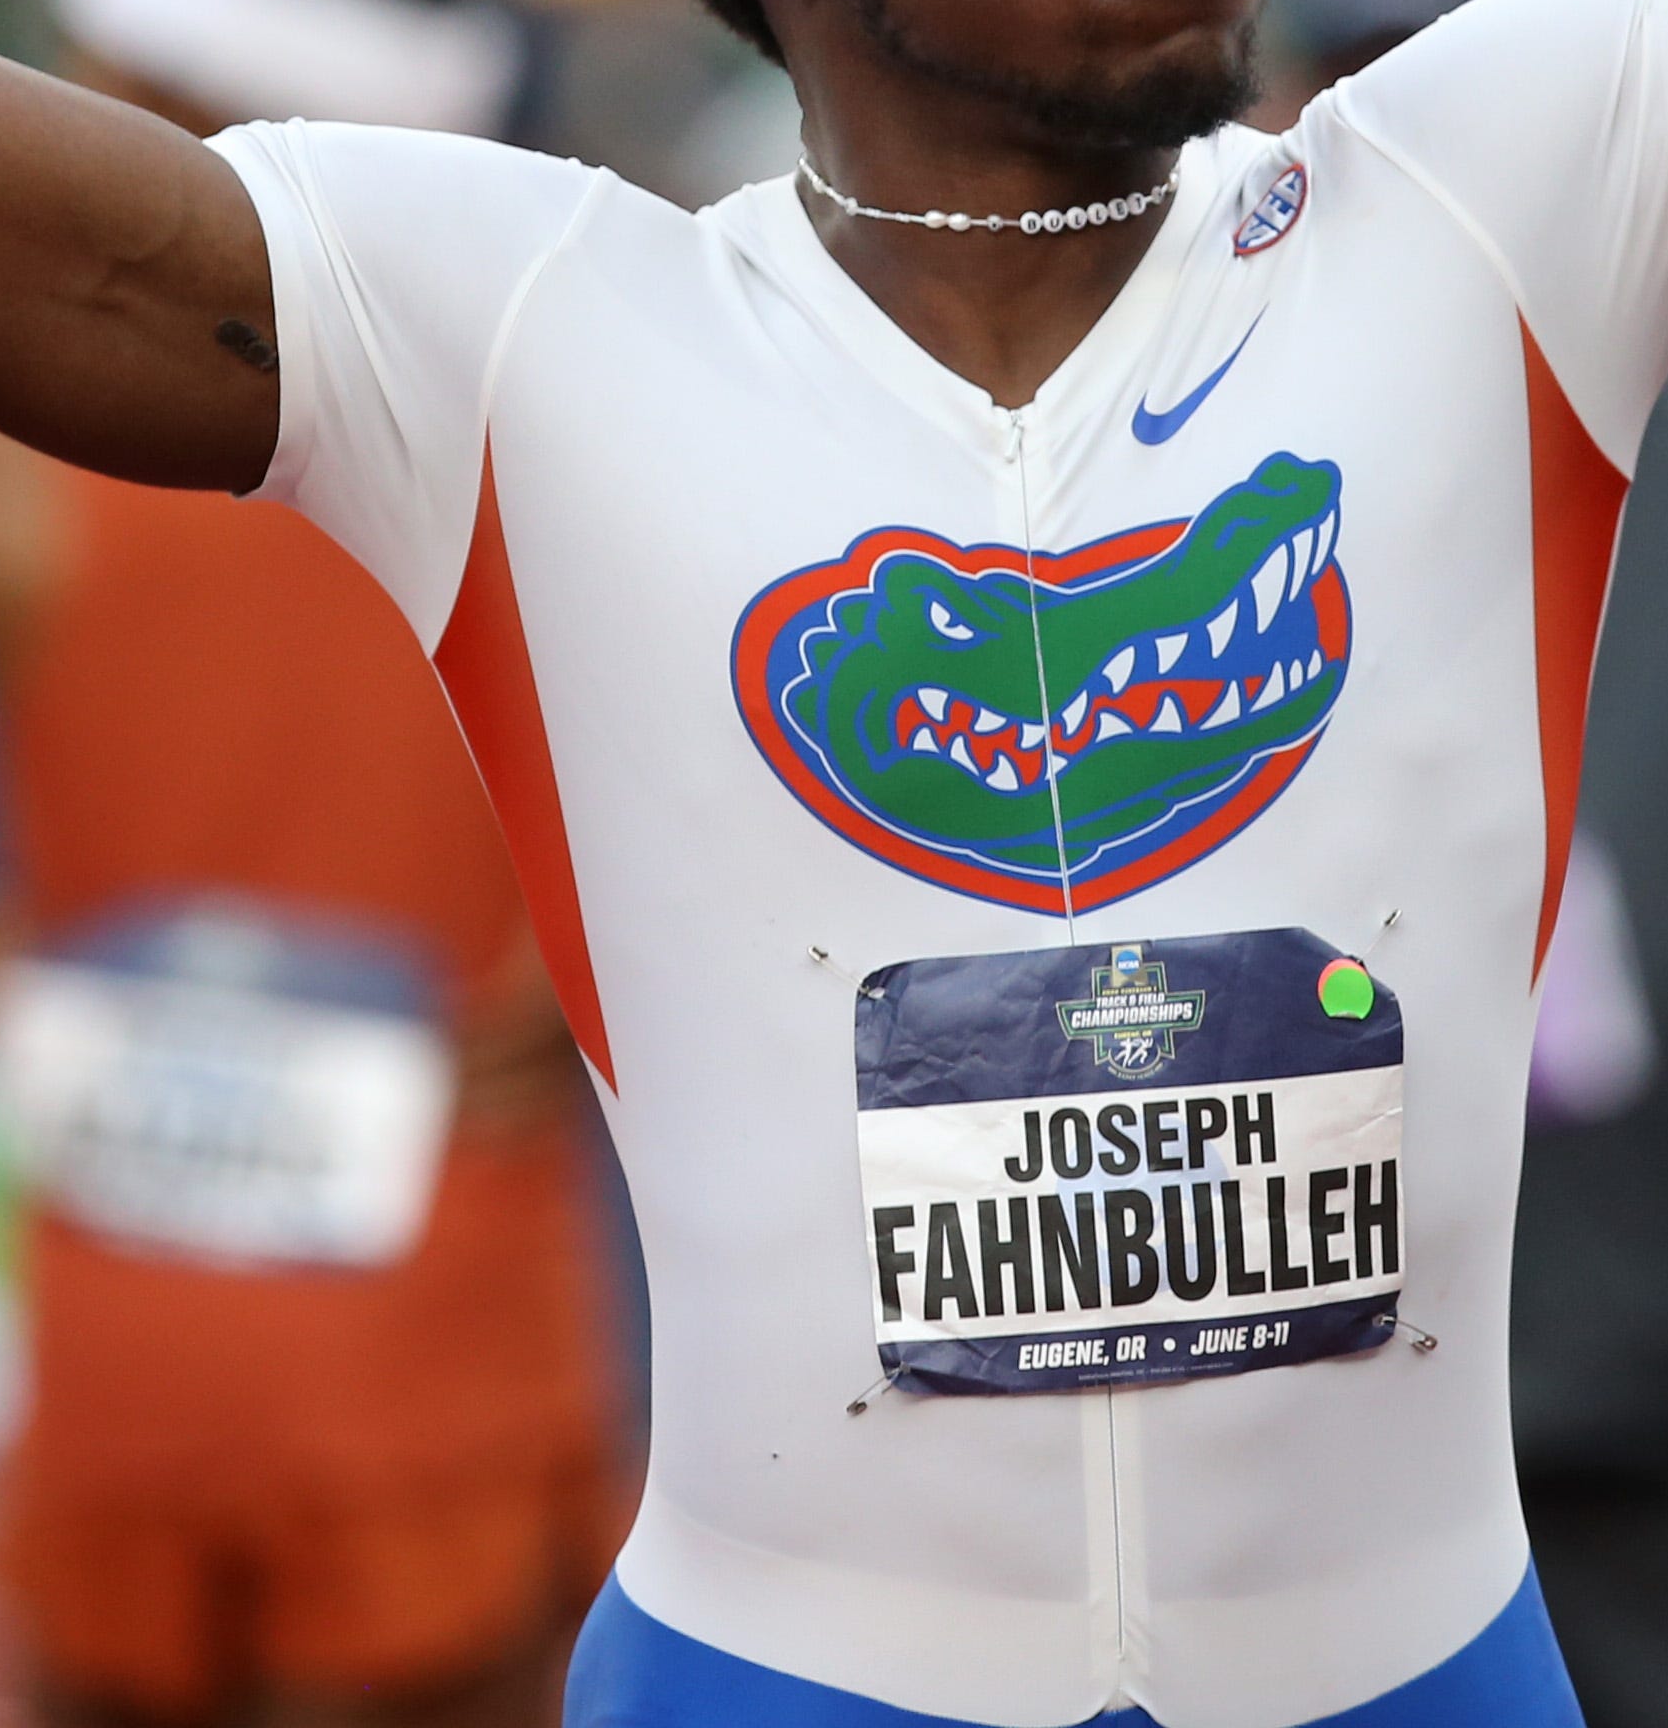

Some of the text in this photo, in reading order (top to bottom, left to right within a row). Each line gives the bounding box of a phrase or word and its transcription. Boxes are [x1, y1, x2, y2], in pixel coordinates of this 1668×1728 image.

[1025, 194, 1144, 232] BULLET
[1071, 1002, 1194, 1029] CHAMPIONSHIPS
[1096, 995, 1128, 1008] TRACK
[1138, 992, 1166, 1006] FIELD
[1004, 1092, 1277, 1183] JOSEPH
[872, 1159, 1400, 1324] FAHNBULLEH
[1018, 1321, 1290, 1370] EUGENE, OR JUNE 8-11
